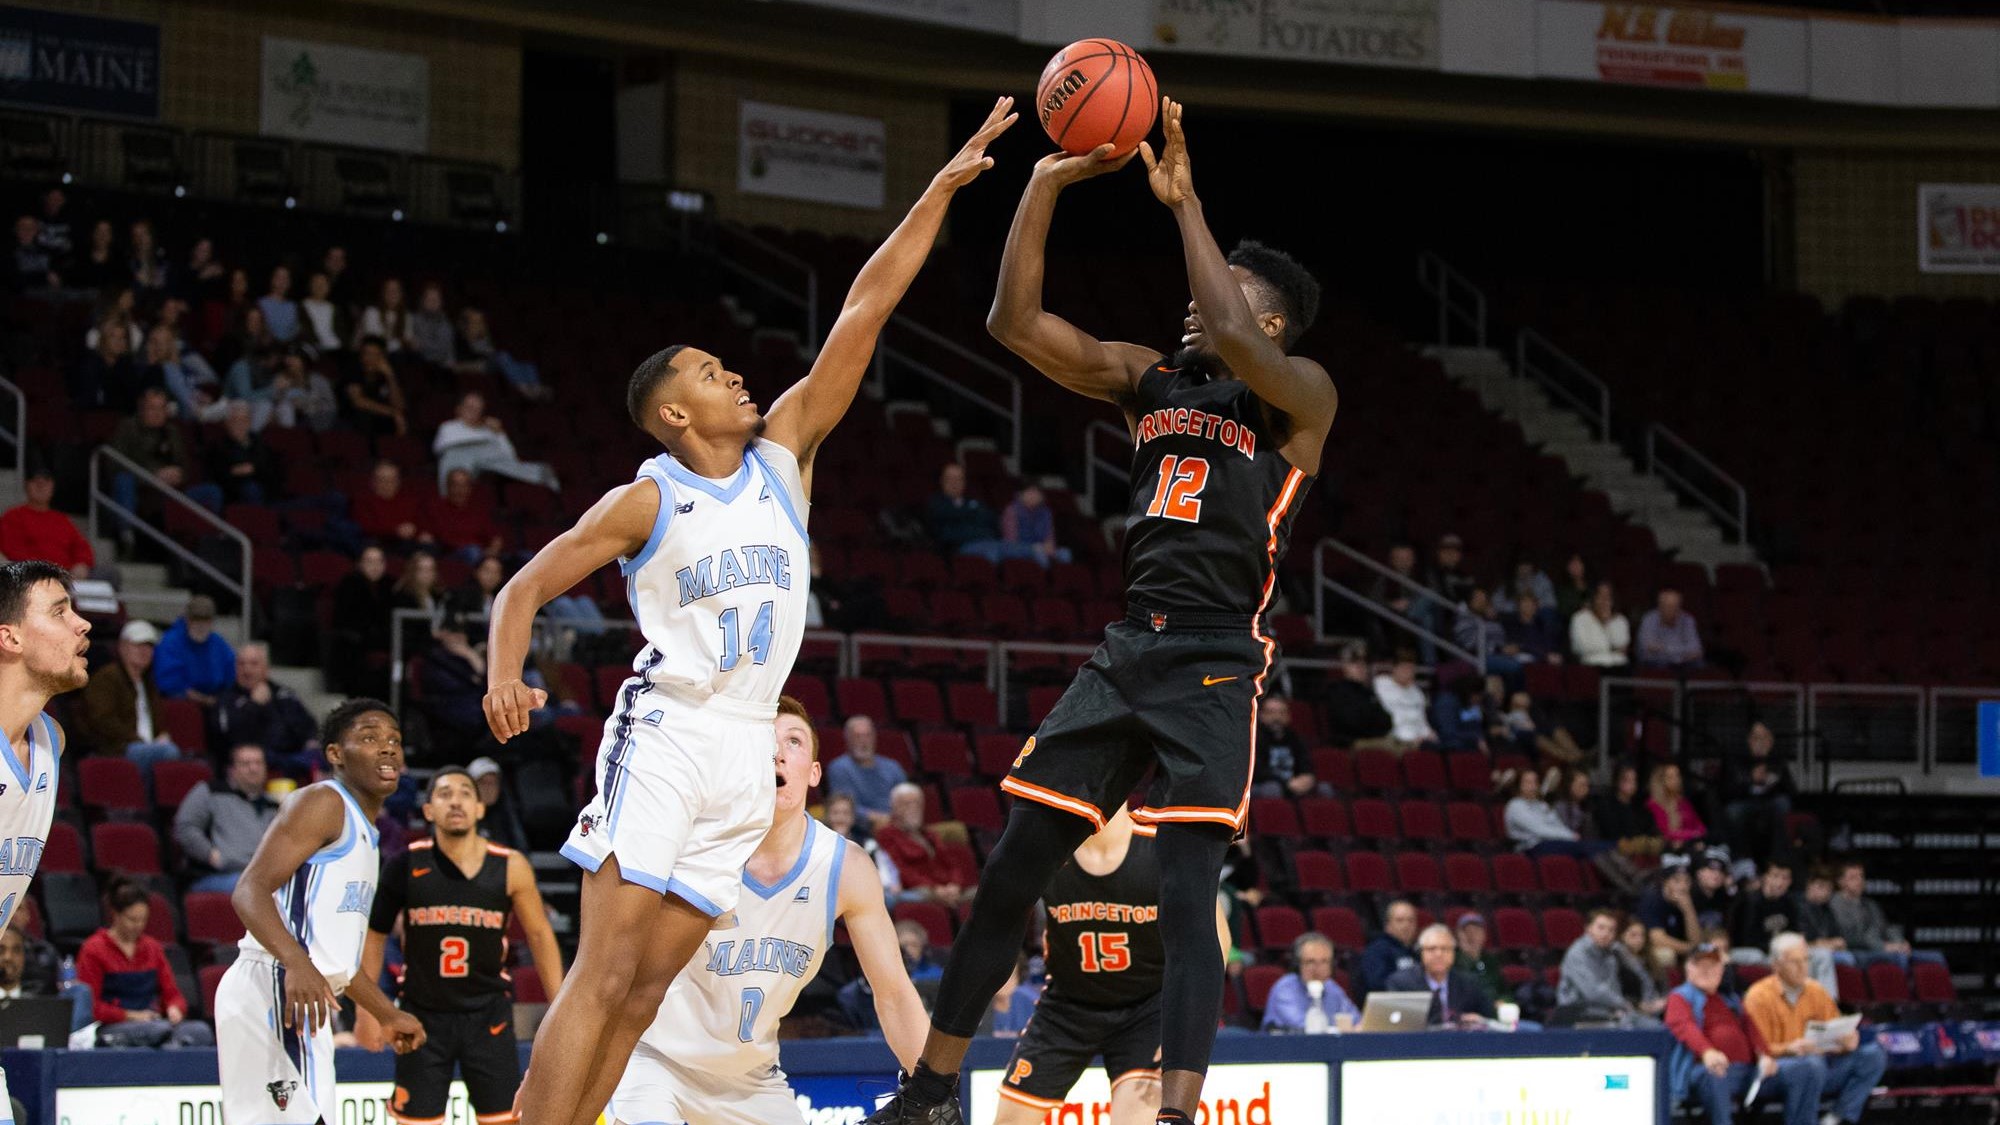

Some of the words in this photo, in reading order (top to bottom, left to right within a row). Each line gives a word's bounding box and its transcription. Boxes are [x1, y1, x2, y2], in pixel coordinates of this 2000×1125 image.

[35, 46, 155, 94] MAINE
[1135, 407, 1256, 461] PRINCETON
[1146, 454, 1210, 523] 12
[675, 544, 790, 608] MAINE
[718, 601, 774, 672] 14
[407, 905, 504, 930] PRINCETON
[1047, 901, 1159, 925] PRINCETON
[439, 936, 470, 978] 2
[705, 936, 815, 979] MAINE
[1078, 931, 1131, 973] 15
[737, 986, 765, 1043] 0
[1008, 1057, 1033, 1086] P
